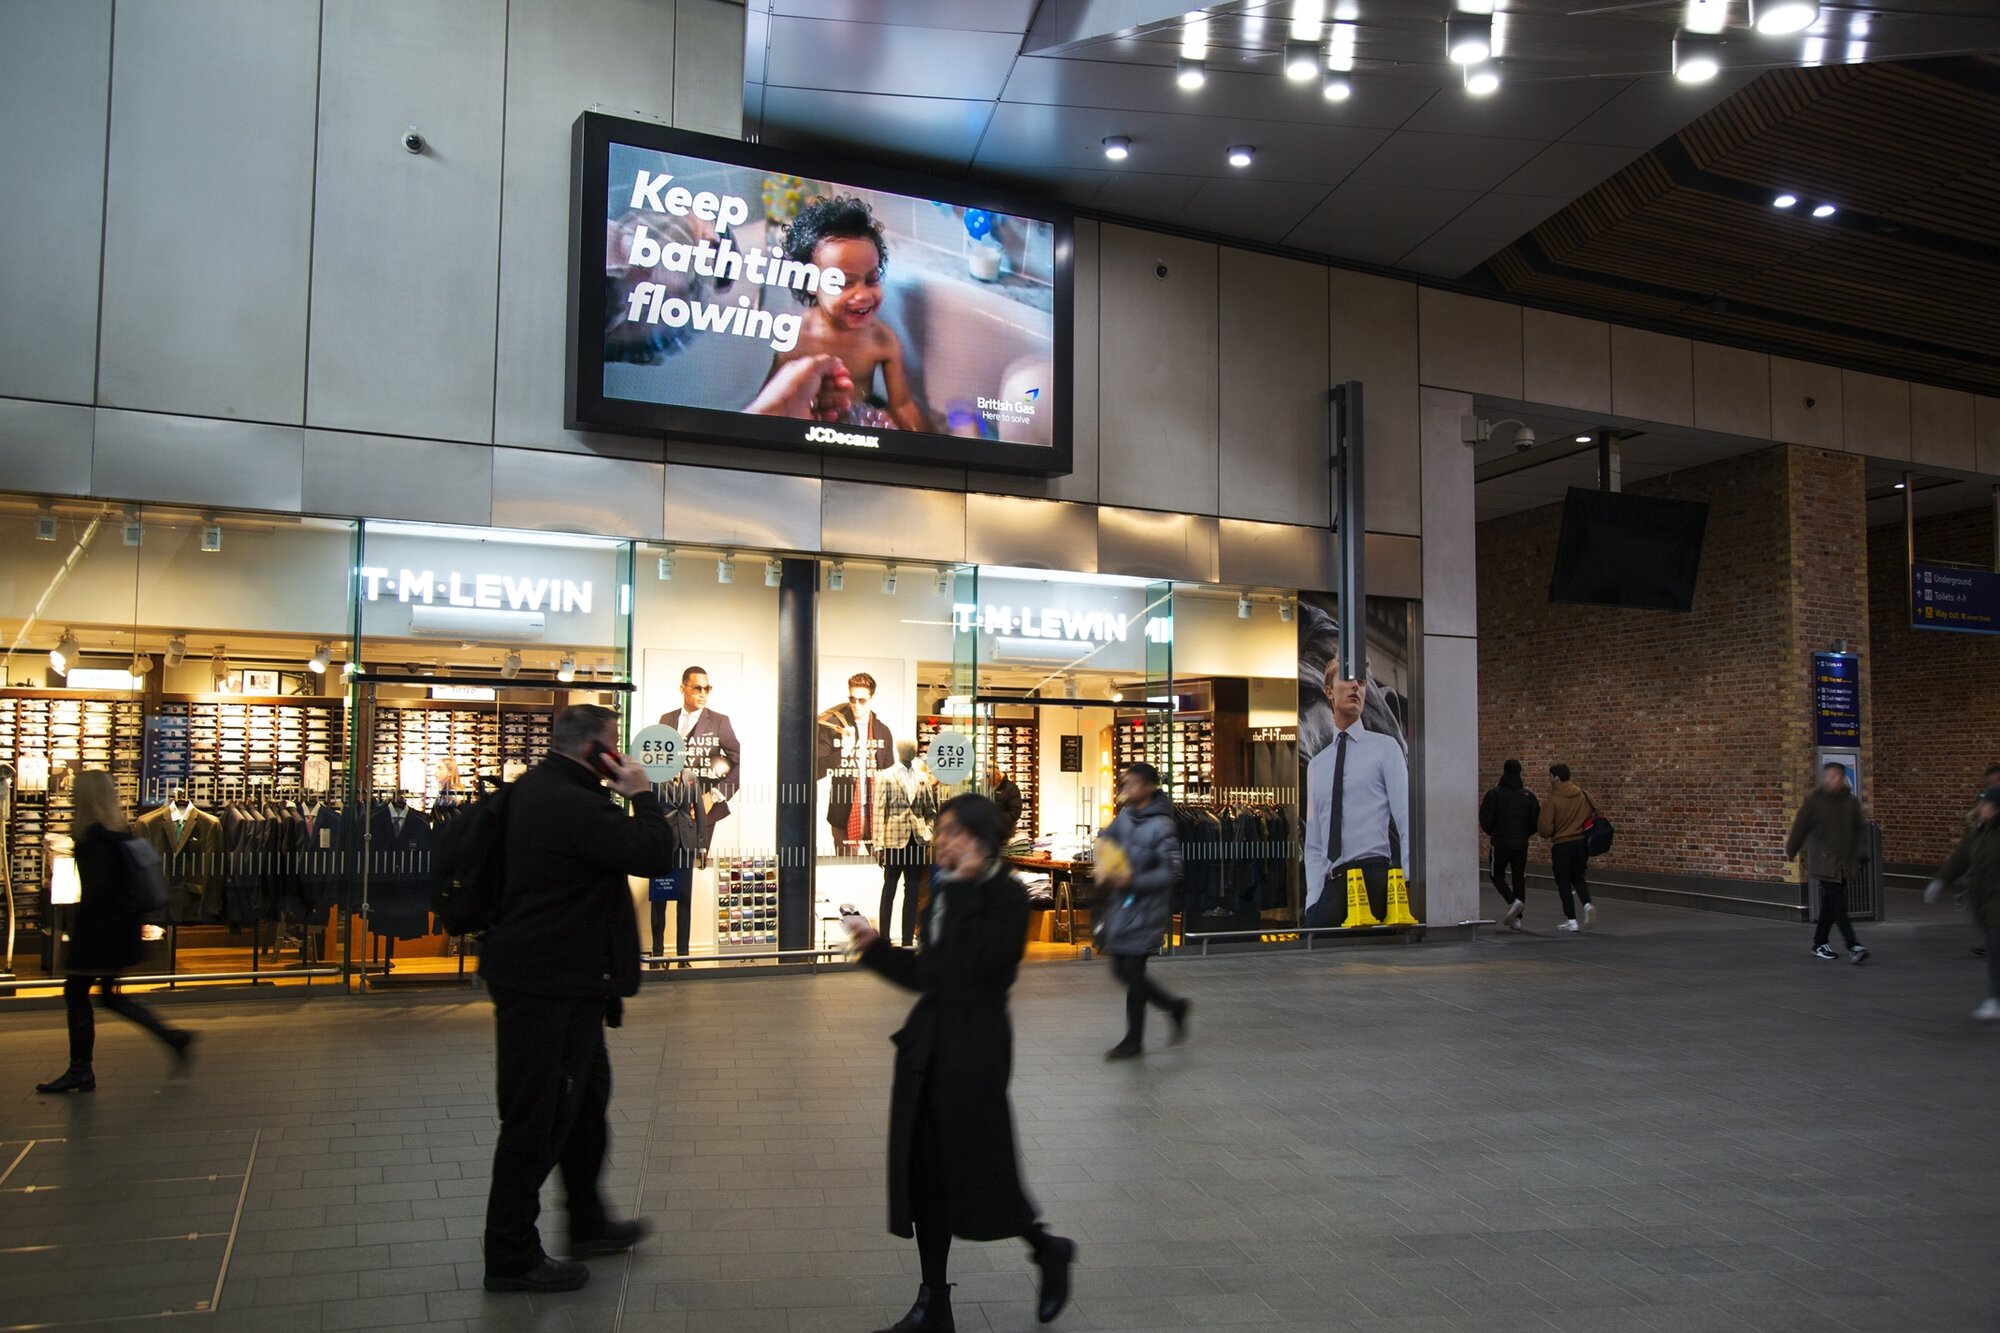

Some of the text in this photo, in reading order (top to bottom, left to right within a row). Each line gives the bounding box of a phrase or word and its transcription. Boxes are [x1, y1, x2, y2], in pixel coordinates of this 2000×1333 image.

[630, 170, 748, 233] Keep
[628, 225, 846, 295] bathtime
[628, 281, 802, 352] flowing
[977, 396, 1036, 415] British Gas
[982, 410, 1030, 424] Here to solve
[805, 426, 880, 448] JCDecaux
[1934, 574, 1972, 586] Underground
[1934, 591, 1954, 602] Toilets
[1935, 609, 1948, 620] Way
[643, 740, 674, 752] £30
[937, 745, 964, 756] £30
[642, 753, 675, 765] OFF
[700, 758, 711, 766] IS
[937, 757, 964, 767] OFF
